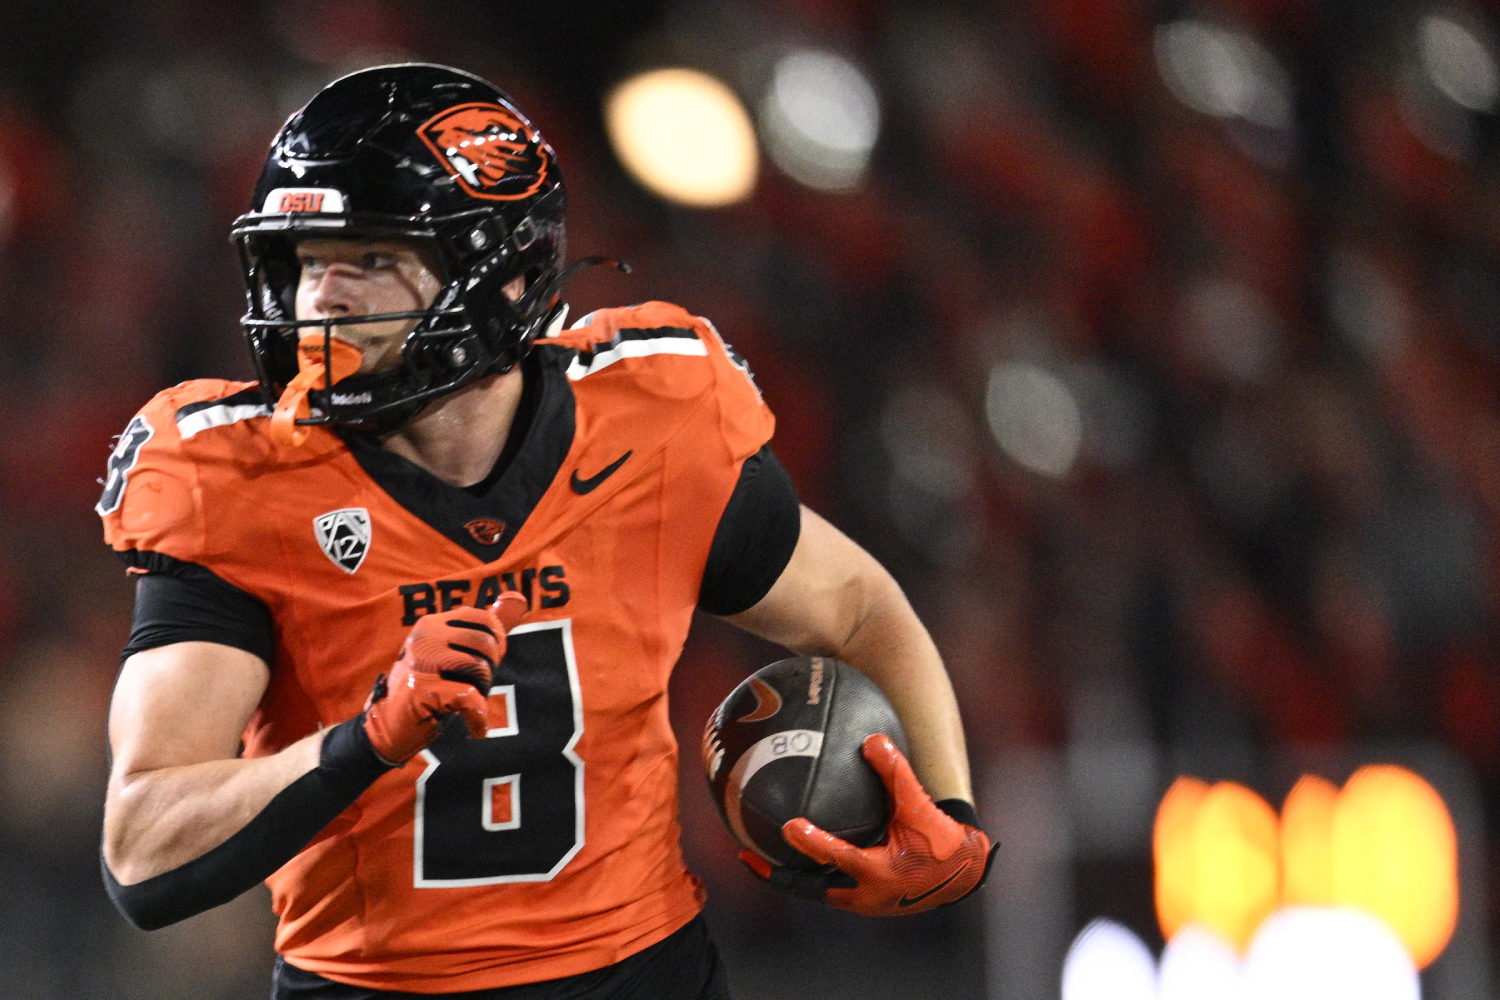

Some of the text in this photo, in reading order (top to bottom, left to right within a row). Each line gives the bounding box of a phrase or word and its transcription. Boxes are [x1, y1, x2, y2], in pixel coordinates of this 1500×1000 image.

[279, 193, 325, 212] OSU
[324, 391, 372, 405] iddell
[316, 511, 368, 552] PAC
[333, 534, 363, 560] 12
[414, 618, 585, 889] 8
